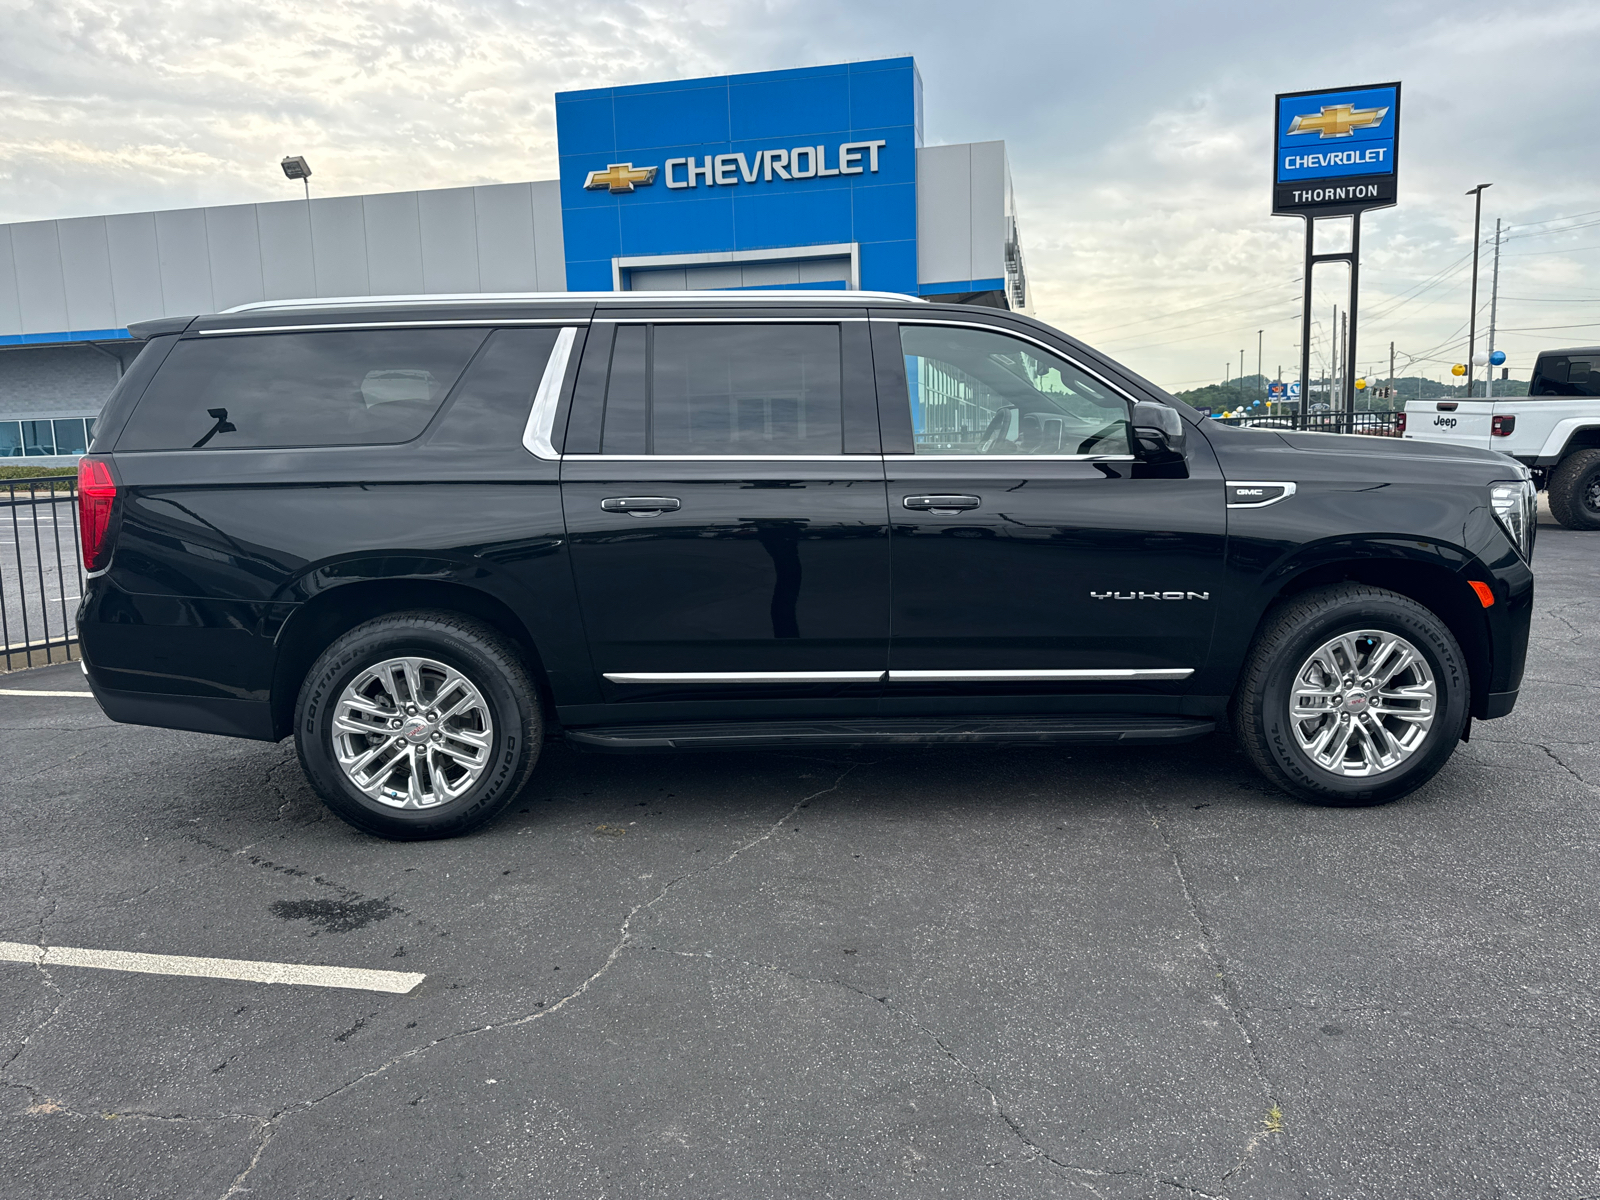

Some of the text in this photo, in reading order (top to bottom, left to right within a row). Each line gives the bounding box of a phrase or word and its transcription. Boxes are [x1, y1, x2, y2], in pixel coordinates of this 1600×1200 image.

[665, 139, 886, 188] CHEVROLET
[1284, 147, 1387, 170] CHEVROLET
[1292, 184, 1379, 203] THORNTON
[1433, 414, 1457, 429] Jeep
[1236, 488, 1263, 496] GMC
[1090, 591, 1210, 600] YUKON
[306, 638, 392, 735] CONTINENT
[1270, 722, 1373, 800] CONTINENTAL
